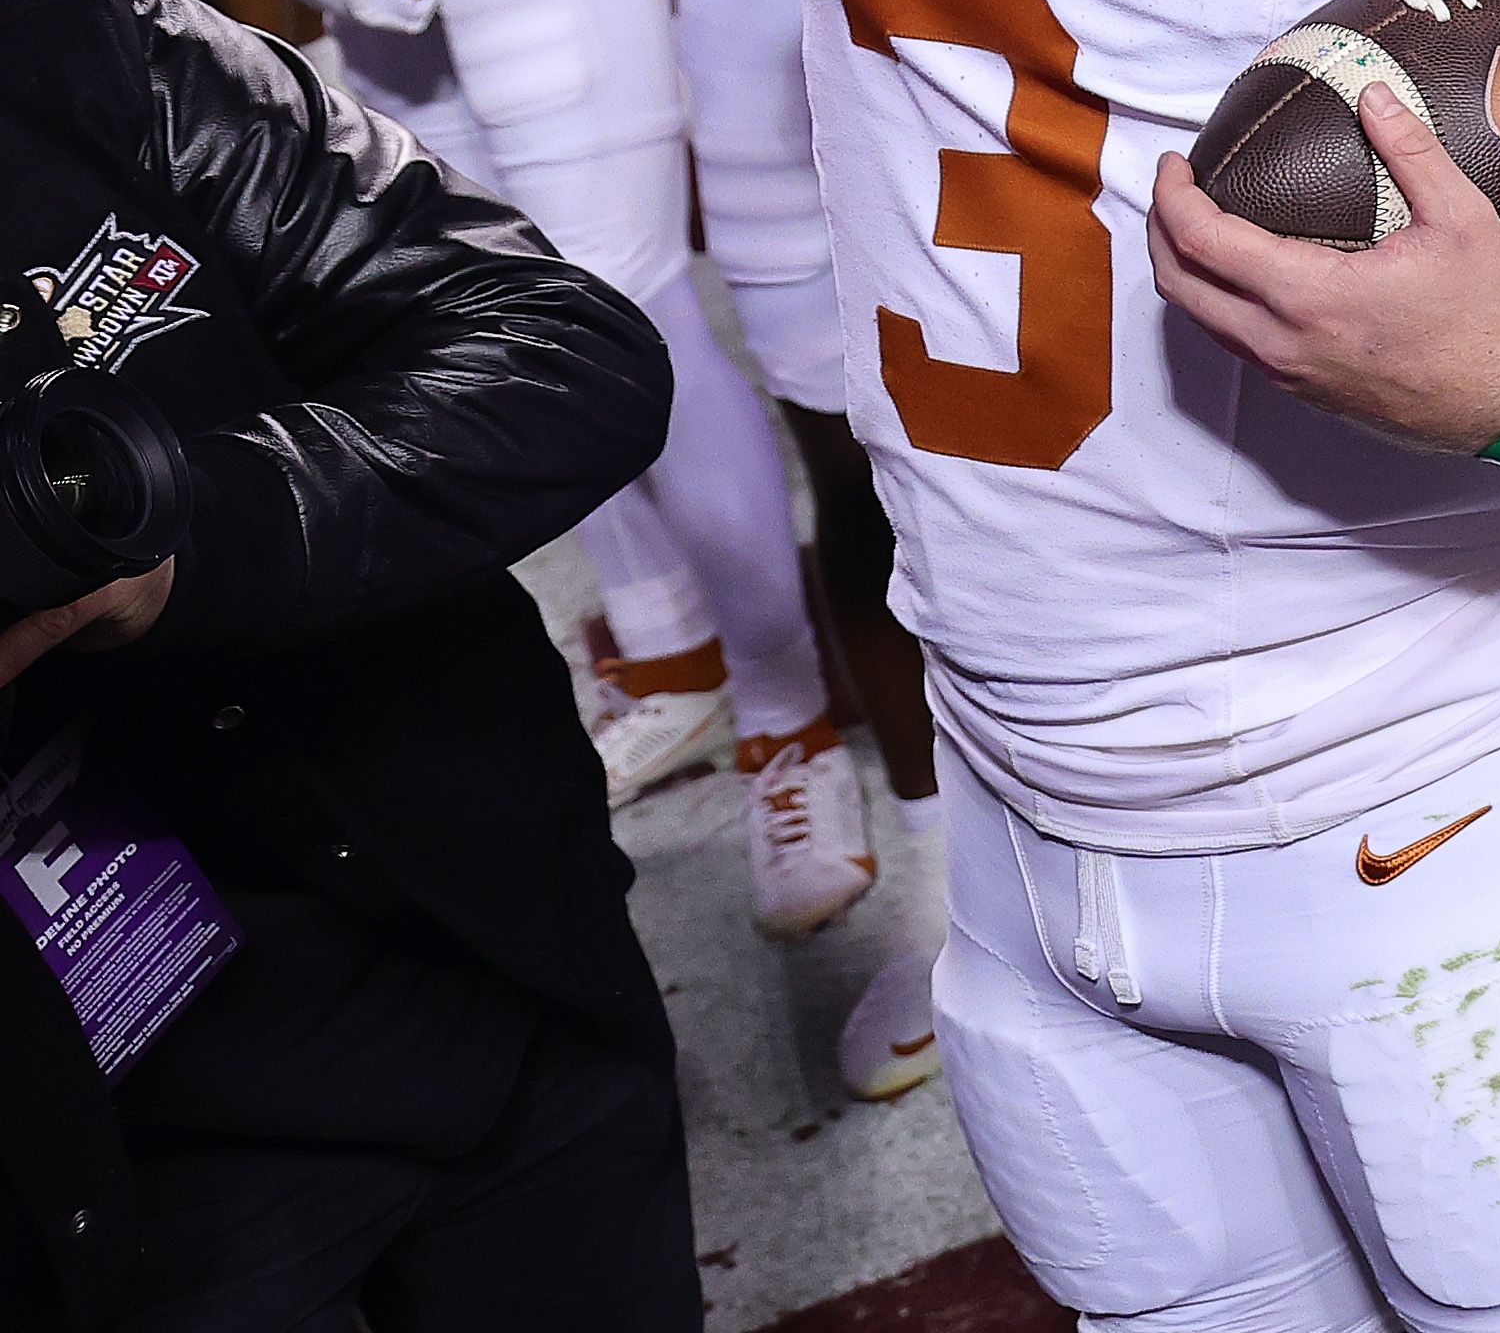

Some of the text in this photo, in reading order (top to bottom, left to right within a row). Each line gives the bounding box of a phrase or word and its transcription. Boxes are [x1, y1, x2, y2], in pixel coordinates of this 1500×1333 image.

[78, 247, 146, 312] STAR
[14, 820, 85, 917] F
[34, 842, 139, 952] DELINE PHOTO
[84, 881, 122, 924] ACCESS
